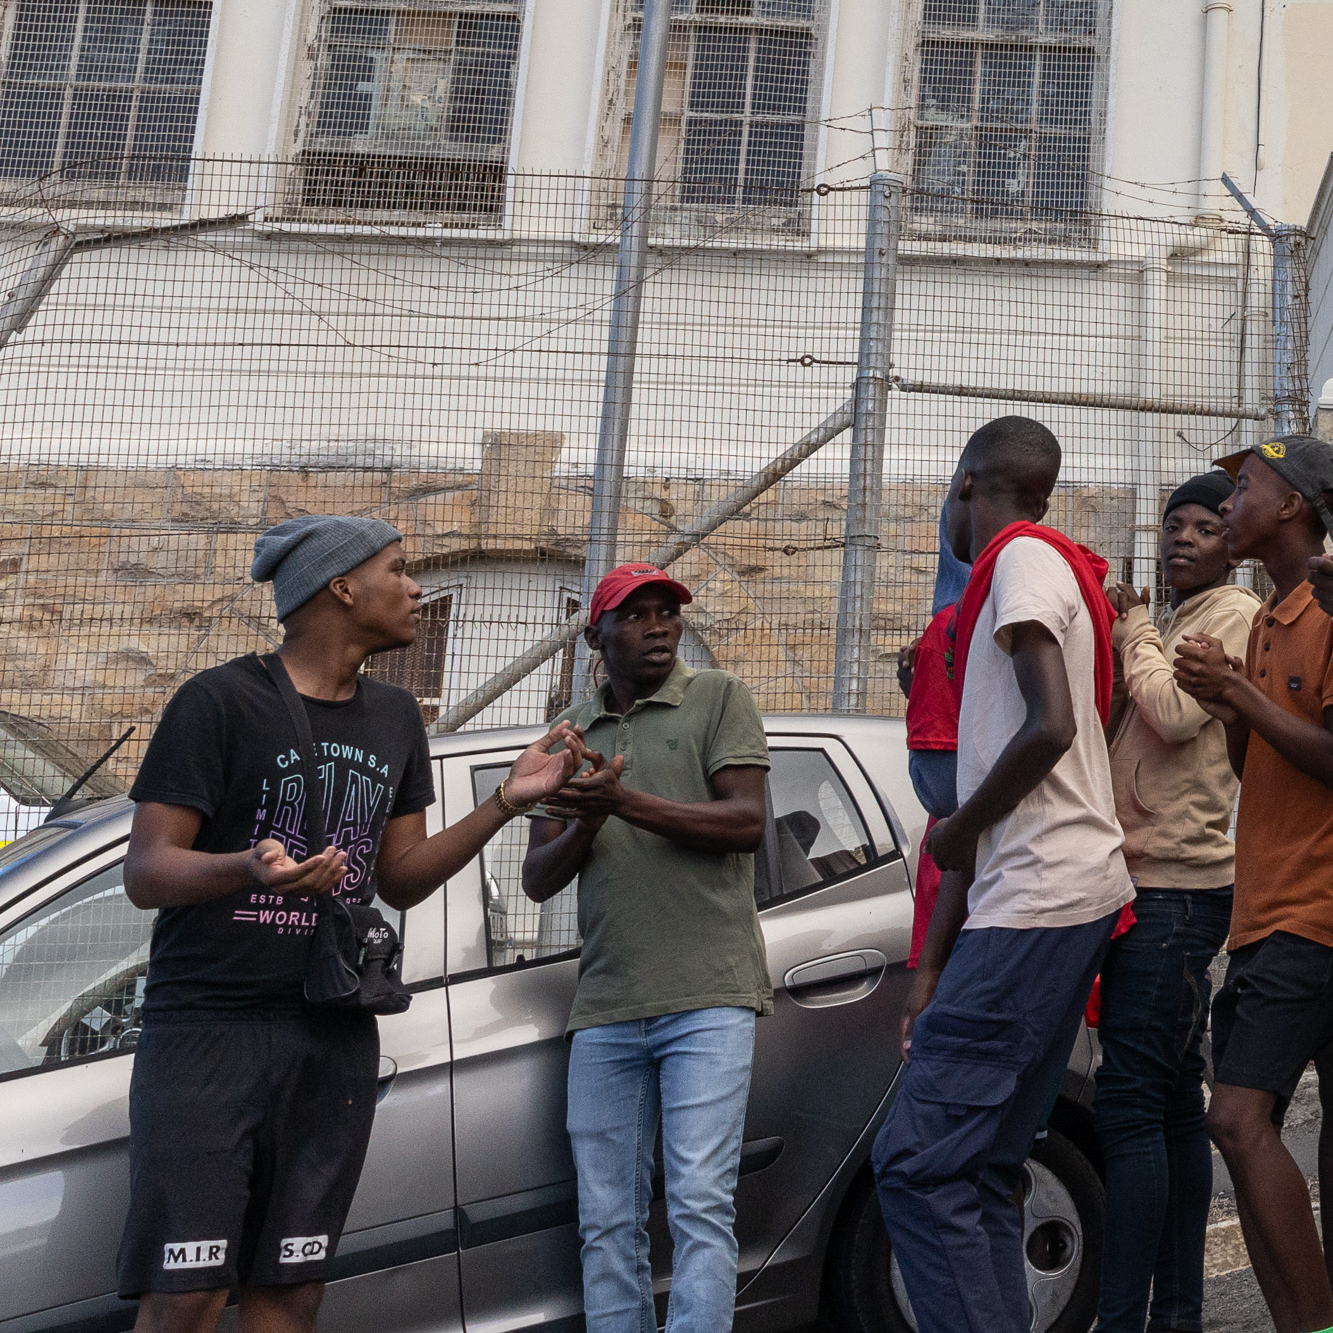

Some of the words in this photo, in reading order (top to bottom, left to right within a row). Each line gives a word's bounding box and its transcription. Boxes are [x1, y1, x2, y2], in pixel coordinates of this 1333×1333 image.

[321, 742, 364, 763] TOWN
[368, 754, 389, 778] S.A
[250, 894, 284, 905] ESTB
[166, 1244, 221, 1264] M.I.R
